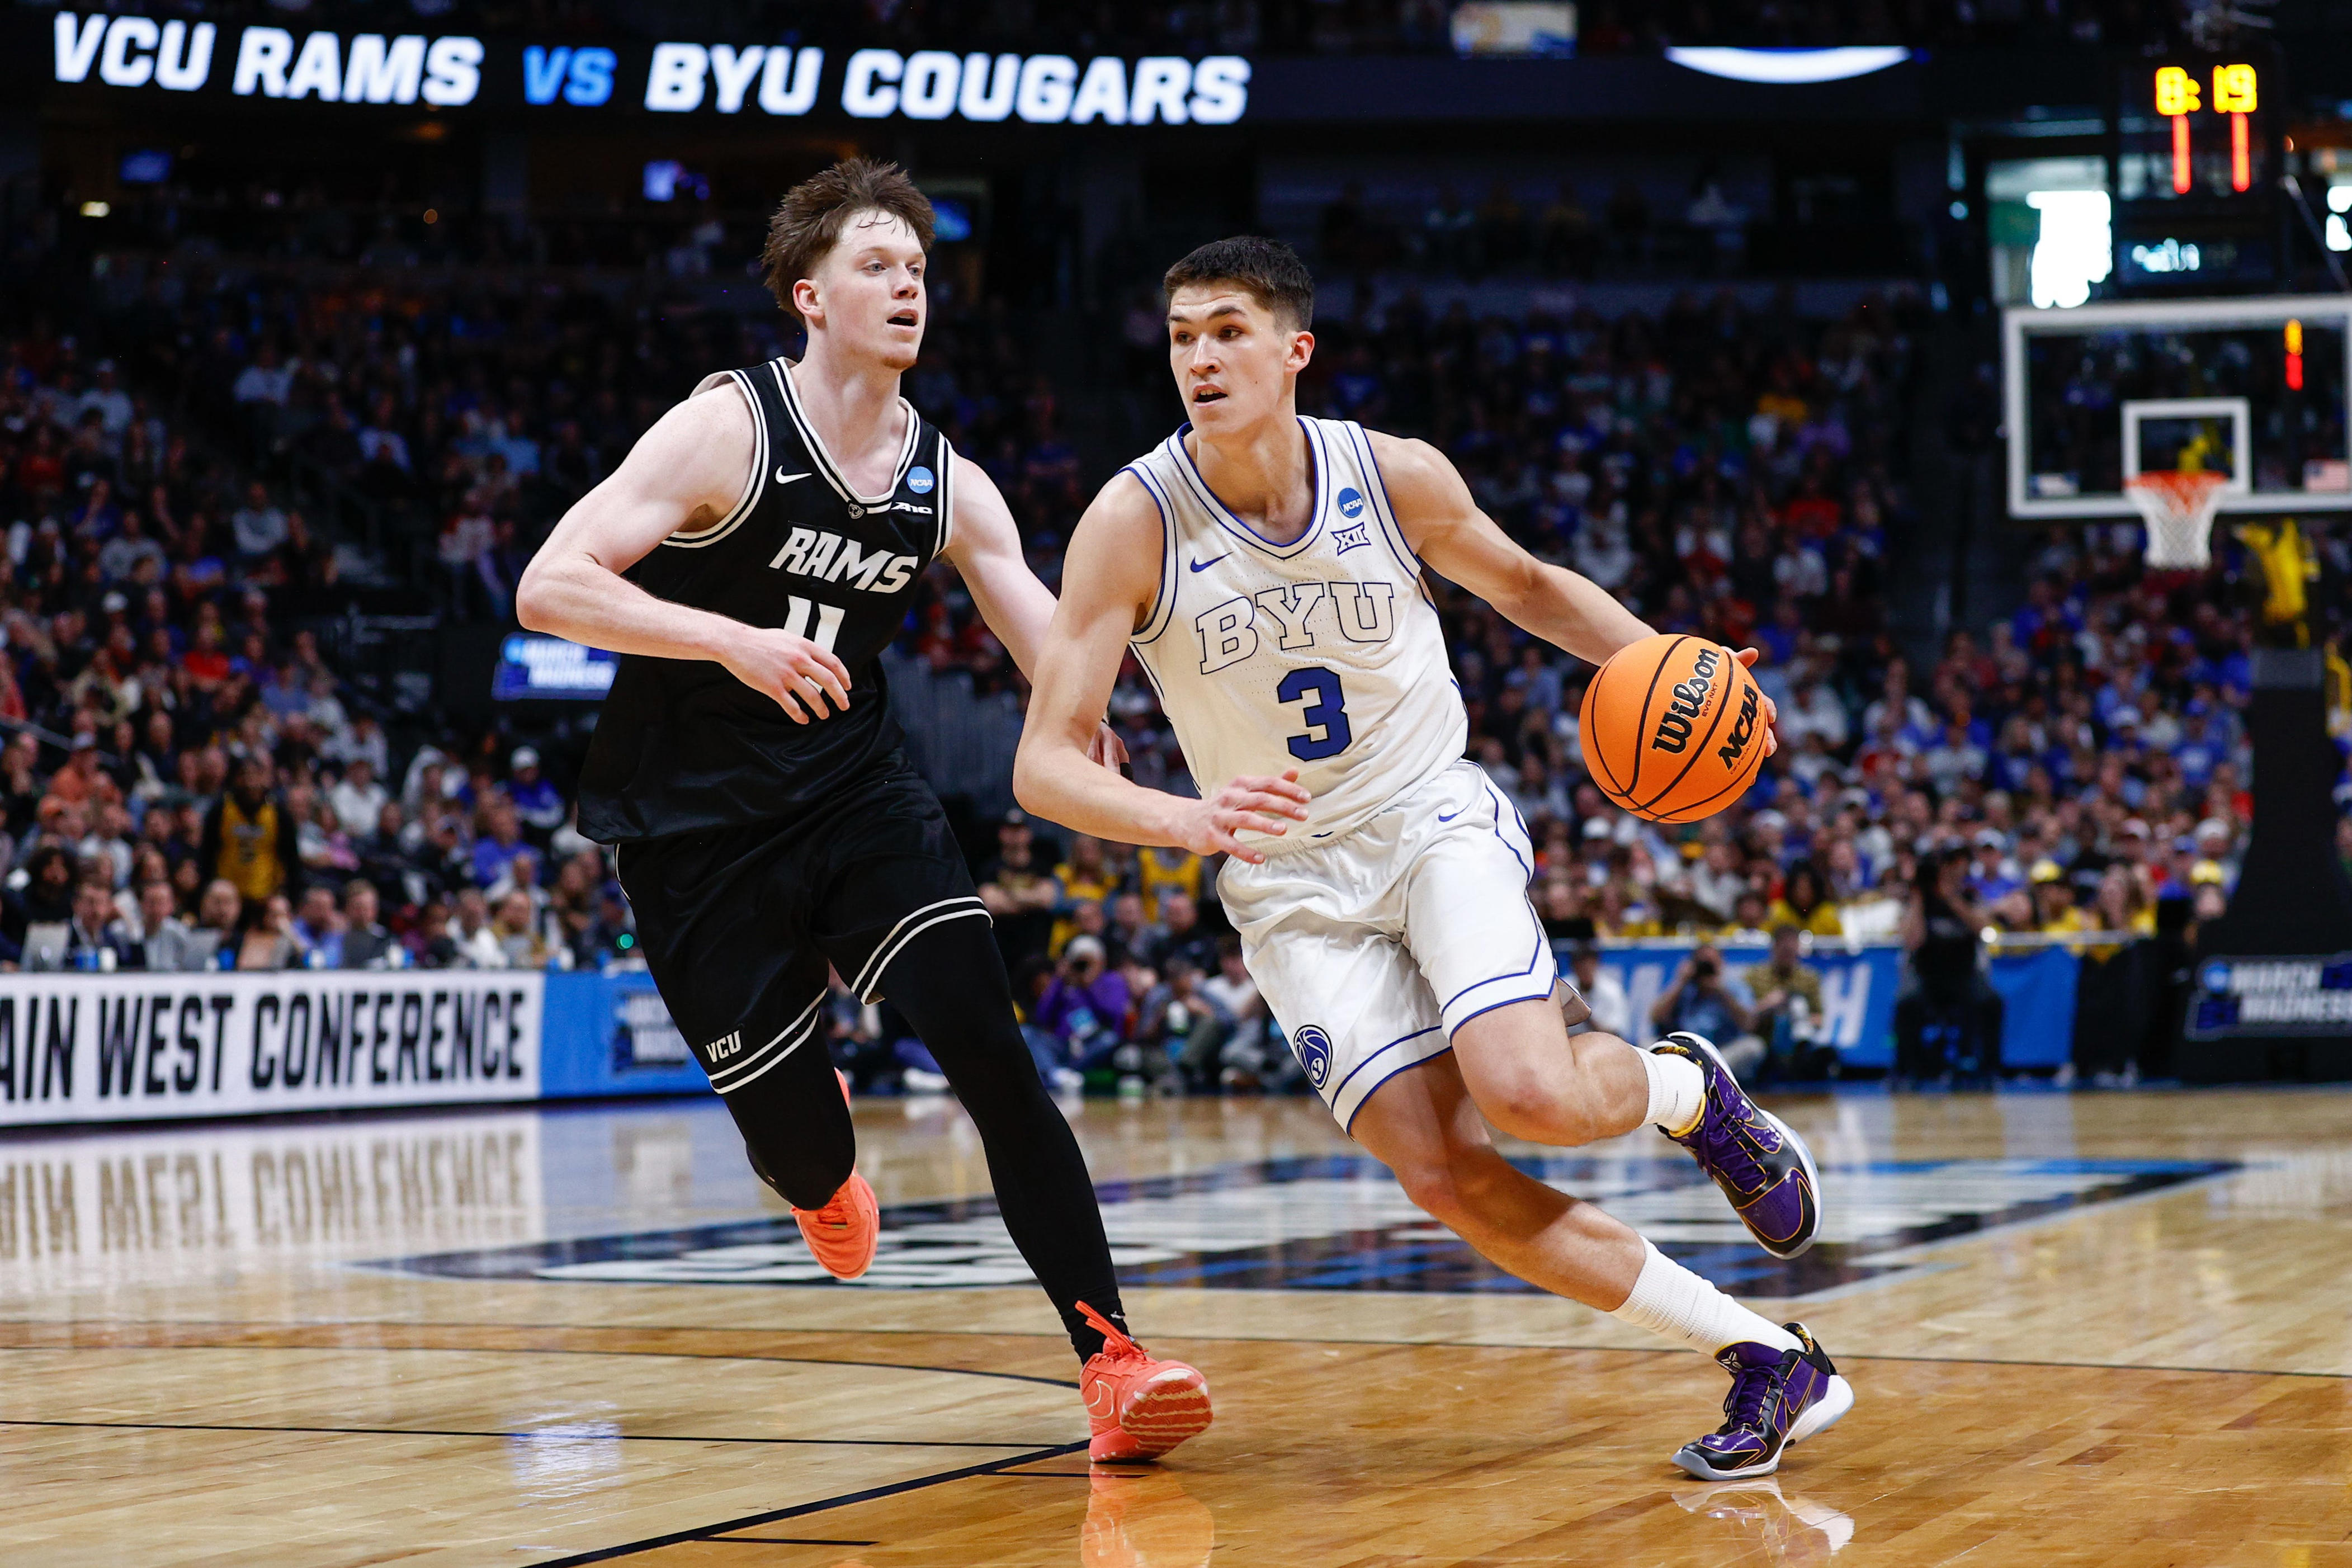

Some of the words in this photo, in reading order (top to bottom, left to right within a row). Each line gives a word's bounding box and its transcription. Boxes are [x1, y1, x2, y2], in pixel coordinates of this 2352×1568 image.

[54, 12, 216, 91] VCU
[233, 26, 484, 106] RAMS
[523, 45, 618, 106] VS
[645, 42, 823, 115] BYU
[842, 49, 1251, 125] COUGARS
[910, 478, 933, 487] NCAA
[1343, 498, 1363, 513] NCAA
[768, 526, 919, 594] RAMS
[1196, 581, 1394, 675] BYU
[1276, 666, 1352, 762] 3
[1651, 648, 1721, 754] Wilson
[1702, 700, 1712, 717] EVO
[1708, 682, 1719, 698] NXT
[1717, 683, 1759, 771] NCAA
[98, 994, 234, 1097] WEST
[250, 991, 524, 1091] CONFERENCE
[706, 1029, 742, 1063] VCU
